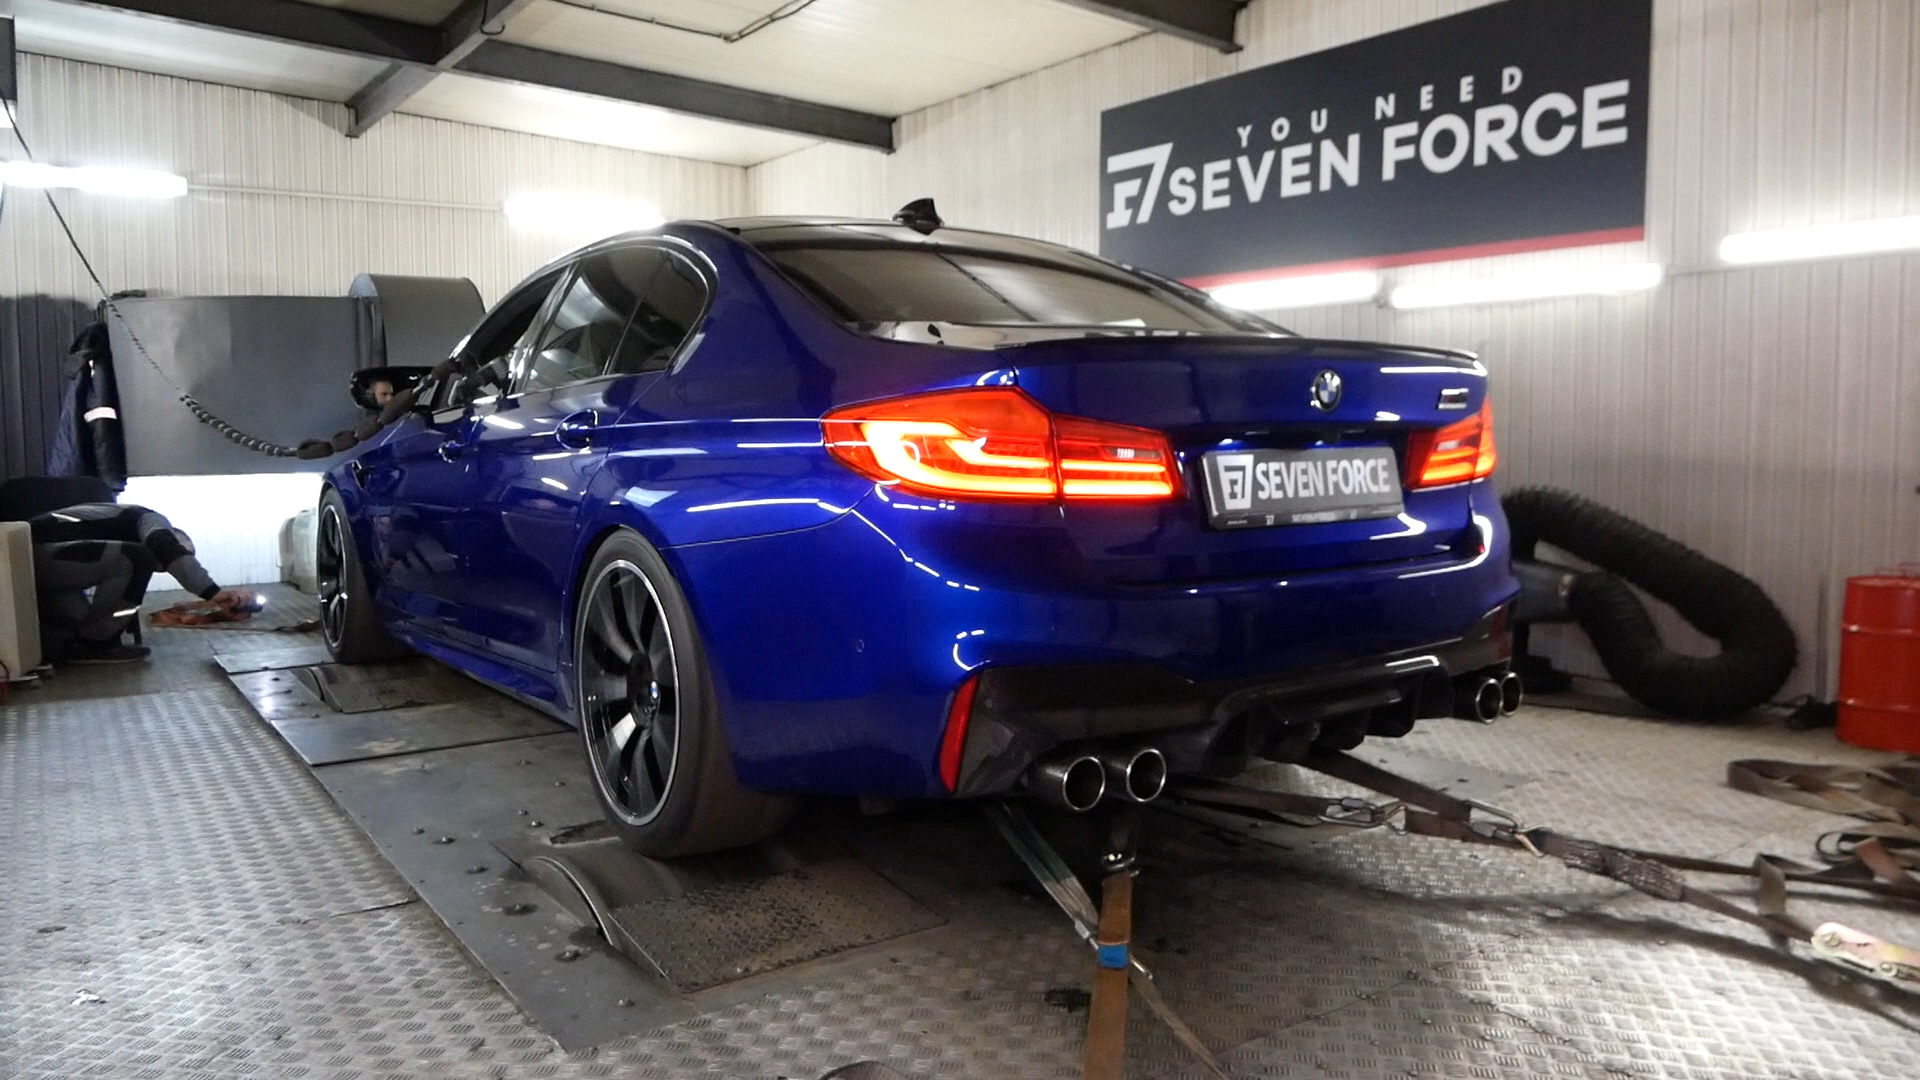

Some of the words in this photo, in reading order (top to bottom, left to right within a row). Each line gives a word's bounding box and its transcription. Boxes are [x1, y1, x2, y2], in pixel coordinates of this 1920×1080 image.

[1237, 109, 1328, 147] YOU
[1375, 66, 1523, 119] NEED
[1168, 133, 1360, 217] SEVEN
[1382, 79, 1630, 182] FORCE
[1256, 460, 1325, 500] SEVEN
[1328, 458, 1391, 496] FORCE
